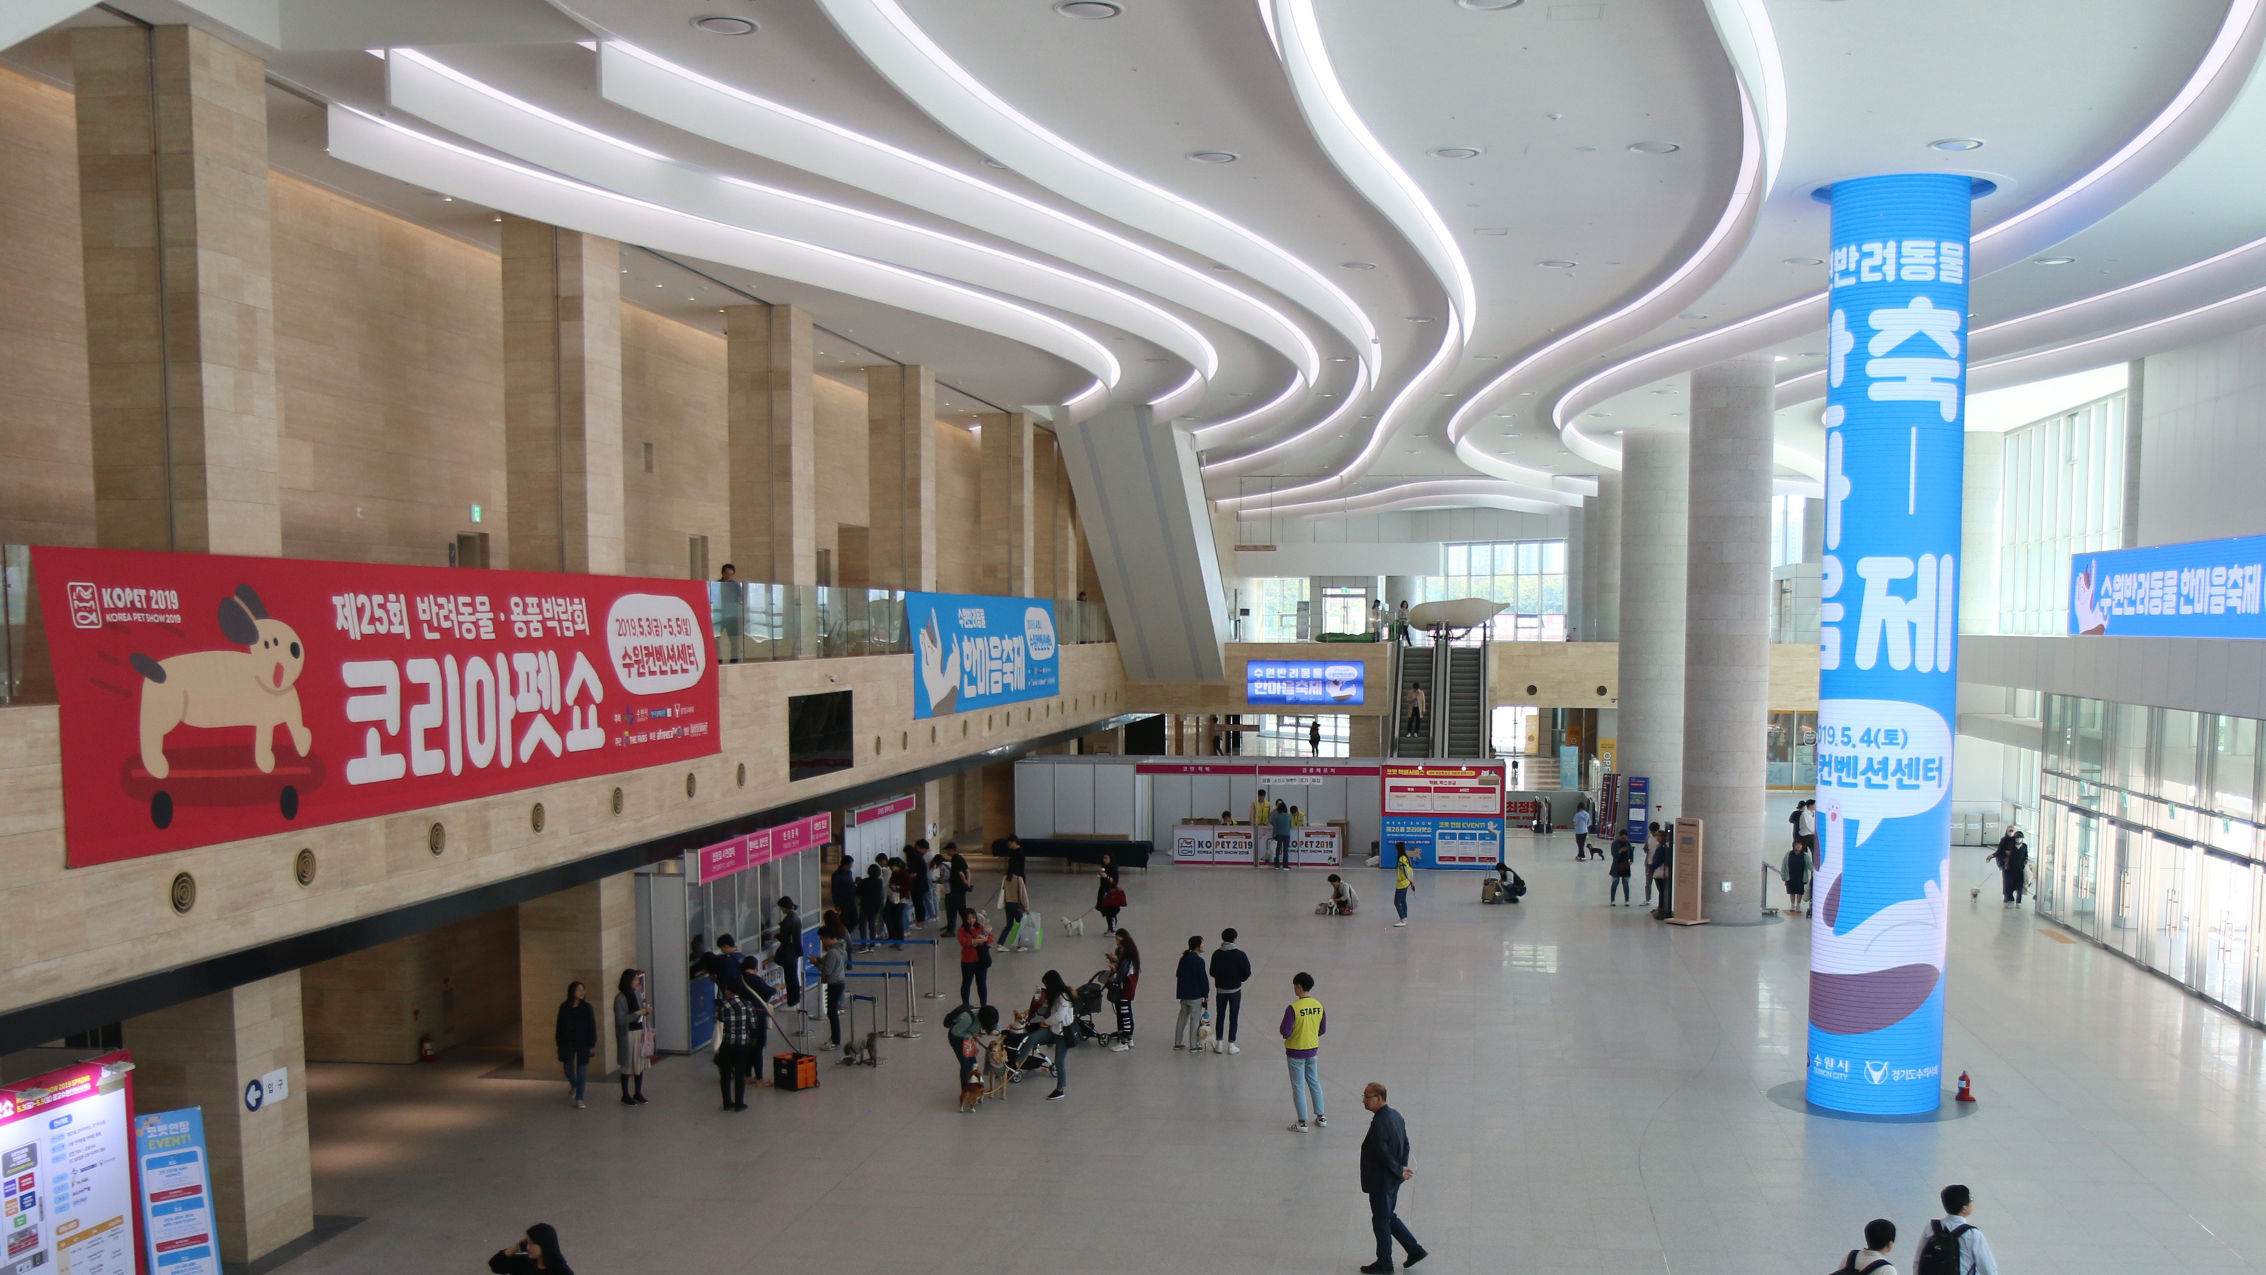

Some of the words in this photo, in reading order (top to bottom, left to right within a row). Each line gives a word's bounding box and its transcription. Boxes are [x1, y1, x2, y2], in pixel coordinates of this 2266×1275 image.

[1829, 240, 1964, 289] 반려동물
[102, 587, 147, 608] KOPET
[150, 589, 179, 610] 2019
[2101, 570, 2178, 616] 수원반려동물
[2179, 564, 2262, 615] 한마음축제
[106, 612, 133, 622] KOREA
[133, 613, 146, 623] PET
[146, 613, 166, 624] SHOW
[166, 614, 182, 624] 2019
[332, 592, 411, 640] 제25회
[622, 643, 699, 678] 수원컨벤션센터
[962, 633, 1026, 698] 한마음축제
[1253, 667, 1323, 679] 수원반려동물
[1254, 680, 1323, 695] 한마음축제
[342, 650, 606, 786] 코리아펫쇼
[1816, 753, 1943, 790] 컨벤션센터
[1197, 840, 1231, 849] KOPET
[1232, 840, 1253, 849] 2019
[1287, 840, 1314, 849] OPET
[1315, 840, 1334, 849] 2019
[1300, 1007, 1321, 1016] STAFF
[1813, 1054, 1849, 1073] 수원시
[267, 1079, 284, 1094] 입구
[148, 1133, 191, 1150] EVENT!
